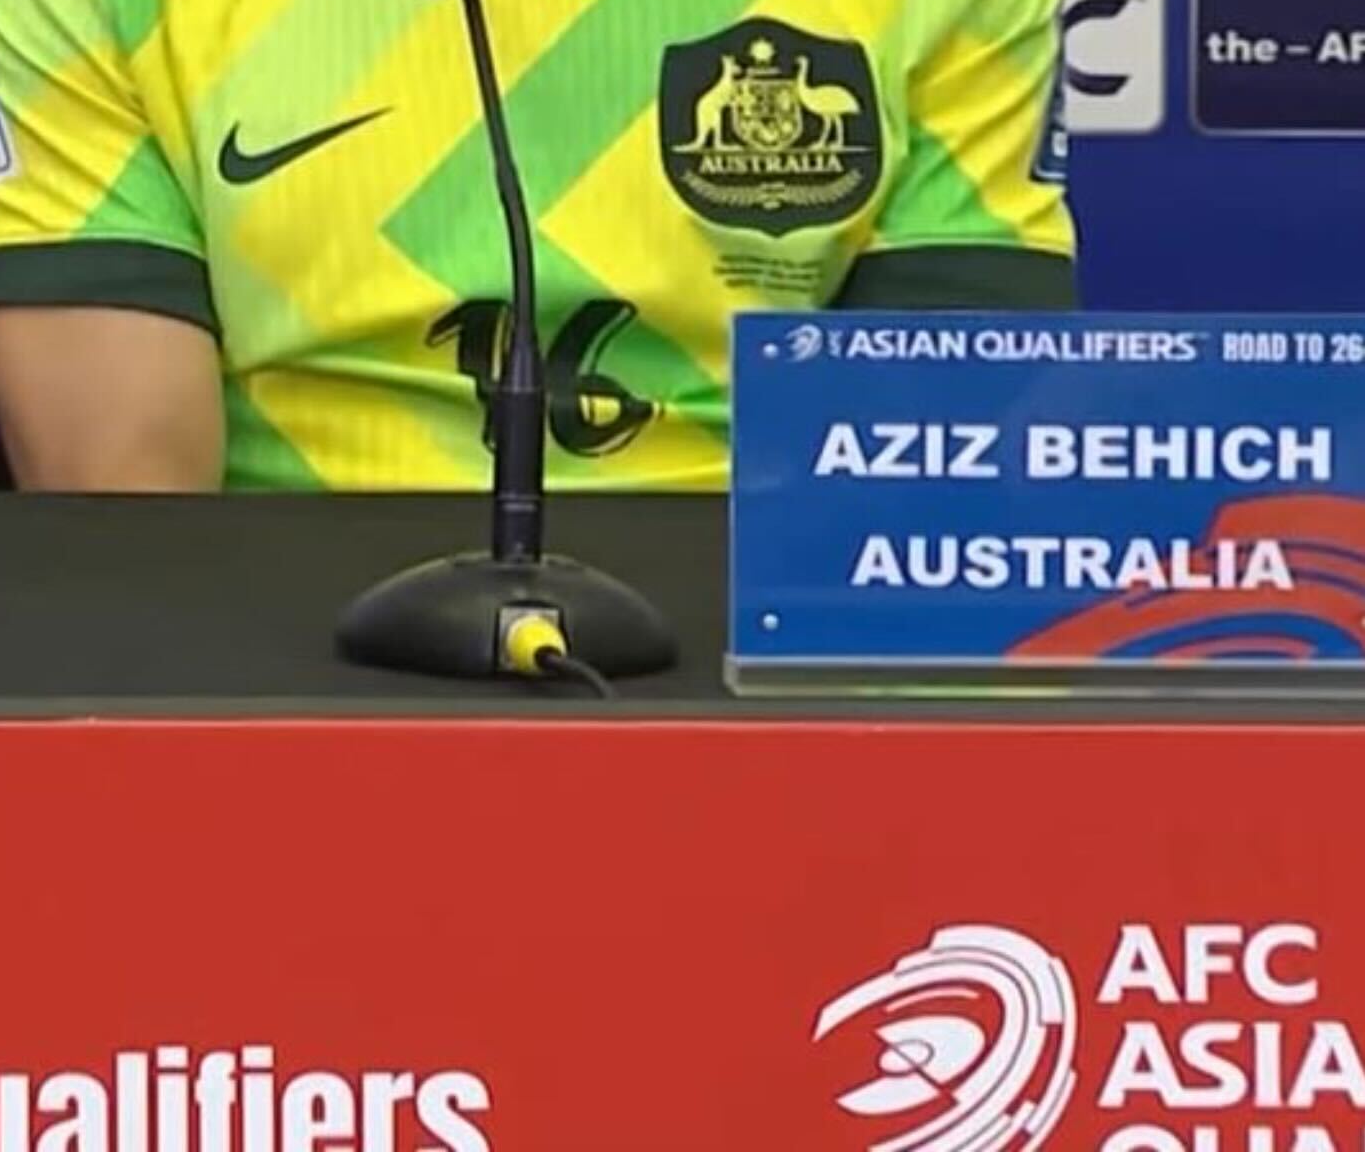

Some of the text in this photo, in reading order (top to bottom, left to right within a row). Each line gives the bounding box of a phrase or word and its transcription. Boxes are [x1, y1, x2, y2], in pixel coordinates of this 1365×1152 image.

[699, 153, 844, 174] AUSTRALIA
[846, 329, 967, 360] ASIAN
[973, 330, 1198, 363] QUALIFIERS
[1223, 332, 1288, 362] ROAD
[1295, 332, 1325, 362] TO
[426, 299, 655, 457] 16
[814, 423, 1331, 480] AZIZ BEHICH
[851, 535, 1292, 590] AUSTRALIA
[1097, 922, 1318, 1005] AFC
